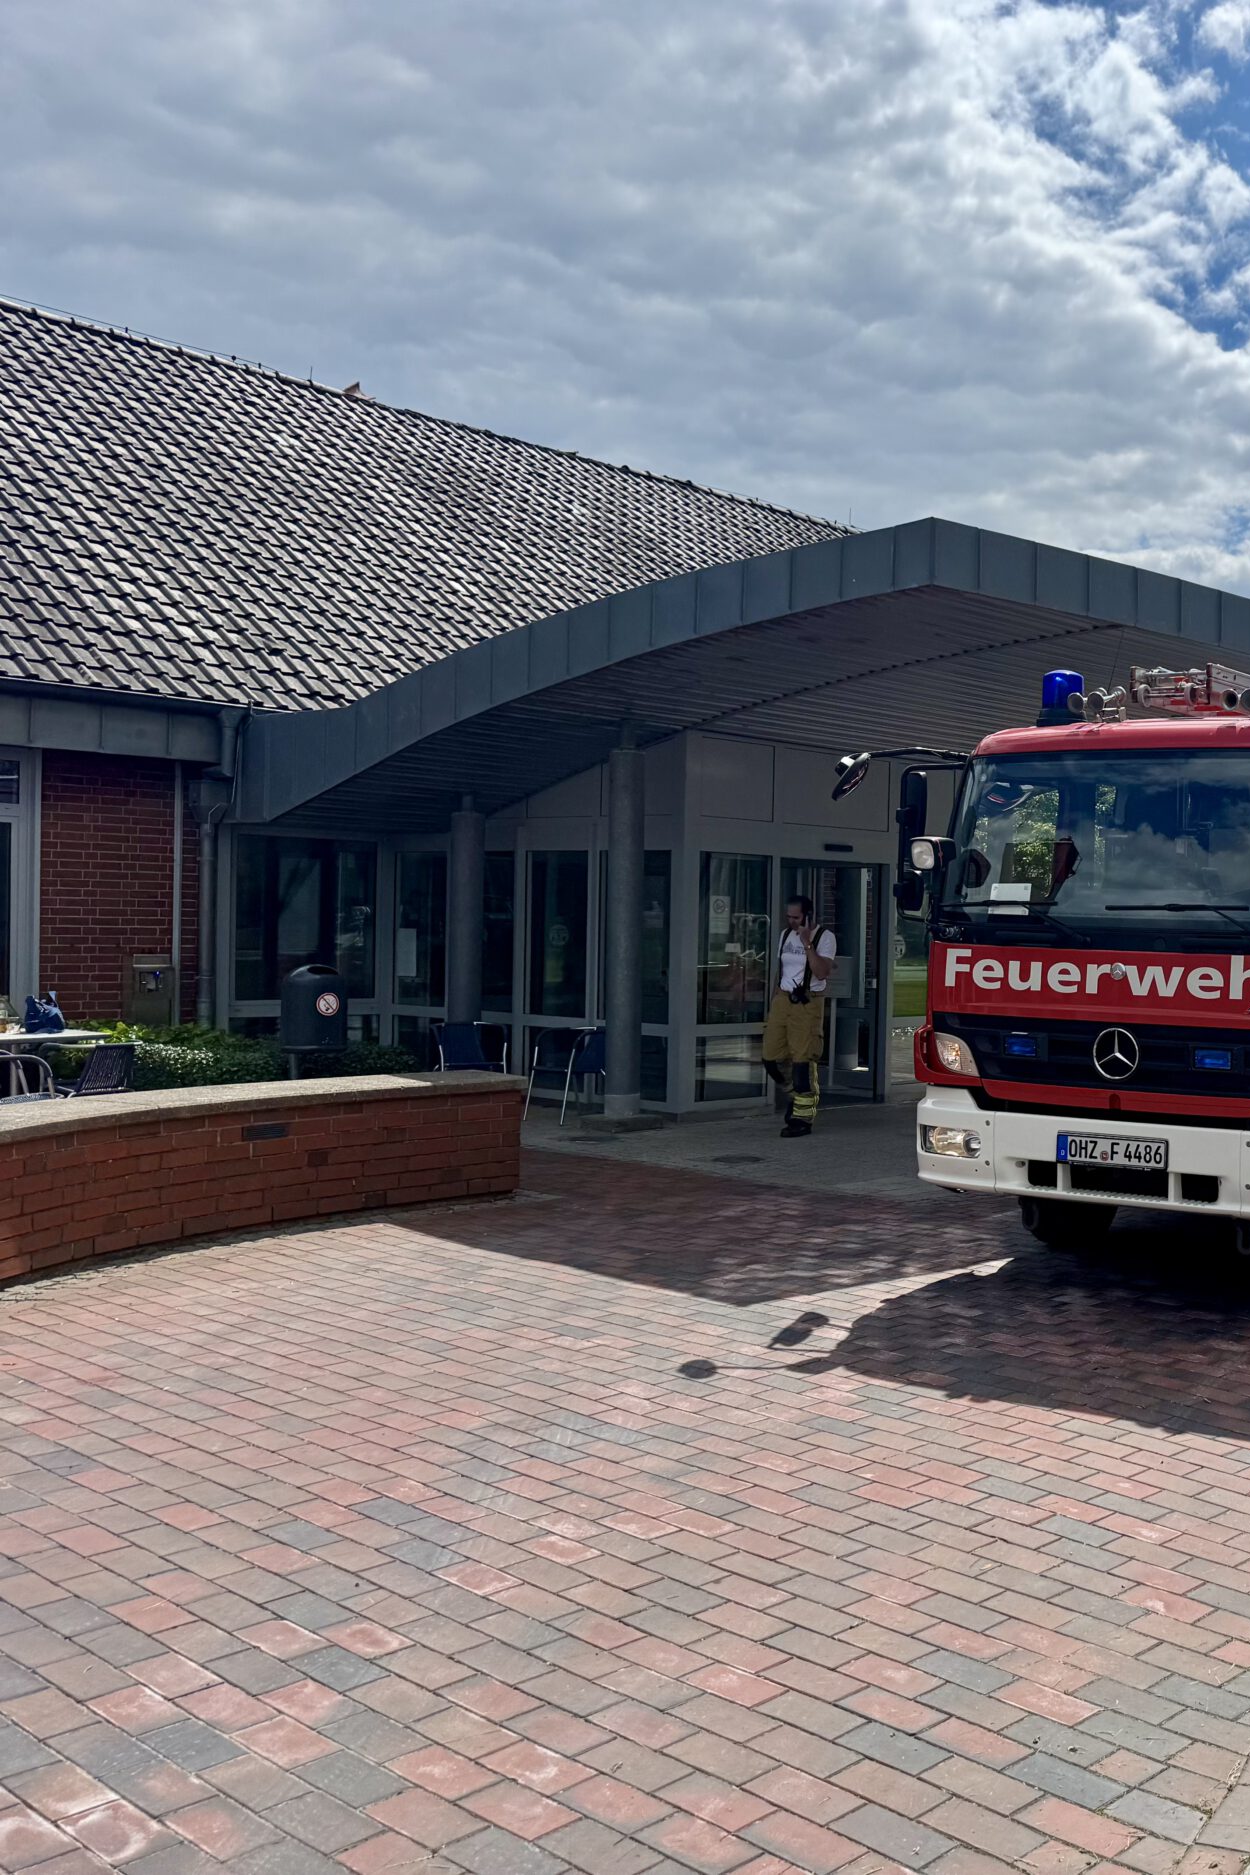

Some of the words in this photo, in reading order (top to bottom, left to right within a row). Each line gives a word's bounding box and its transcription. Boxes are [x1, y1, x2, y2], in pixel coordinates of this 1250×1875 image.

[1068, 1138, 1098, 1159] OHZ
[1110, 1141, 1120, 1161] F
[1123, 1143, 1163, 1165] 4486
